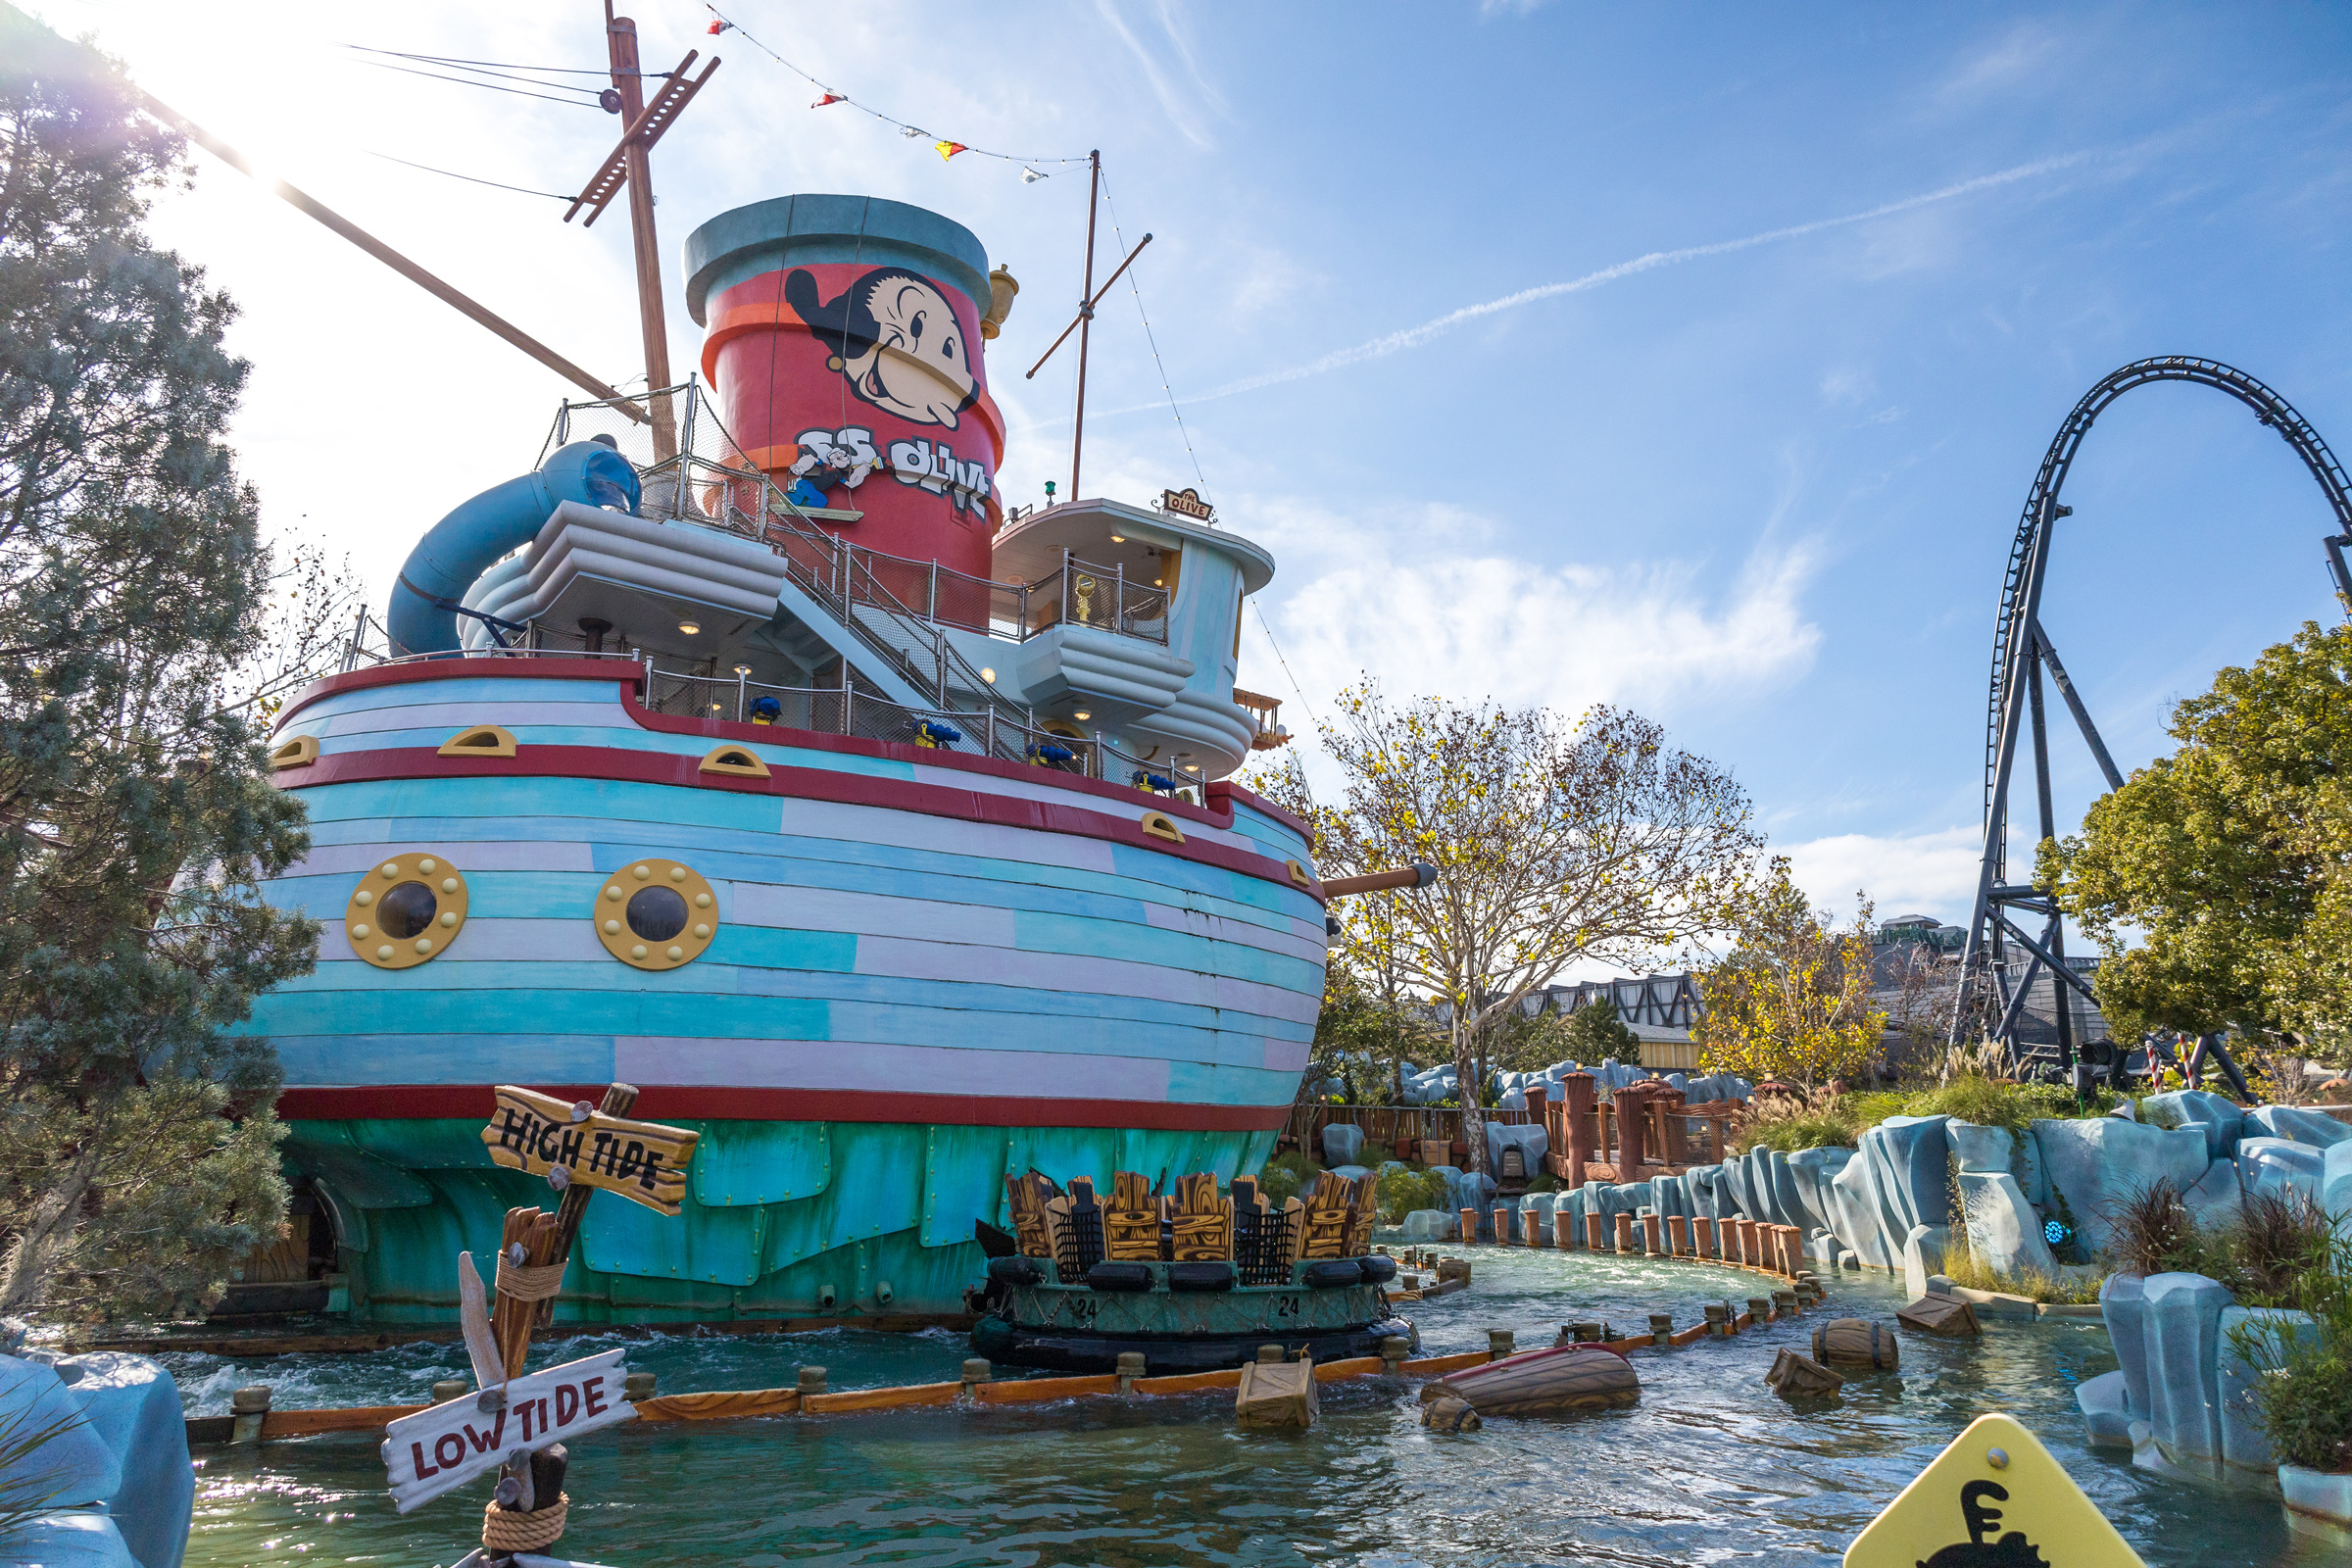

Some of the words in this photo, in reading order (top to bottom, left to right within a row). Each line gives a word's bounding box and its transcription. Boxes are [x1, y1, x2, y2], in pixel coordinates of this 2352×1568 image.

[796, 427, 876, 472] SS
[1171, 498, 1205, 515] OLIVE
[1184, 493, 1196, 503] THE
[500, 1108, 585, 1170] HIGH
[589, 1132, 663, 1191] TIDE
[1077, 1298, 1097, 1319] 24
[1278, 1296, 1298, 1317] 24
[411, 1408, 507, 1481] LOW
[513, 1376, 608, 1443] TIDE
